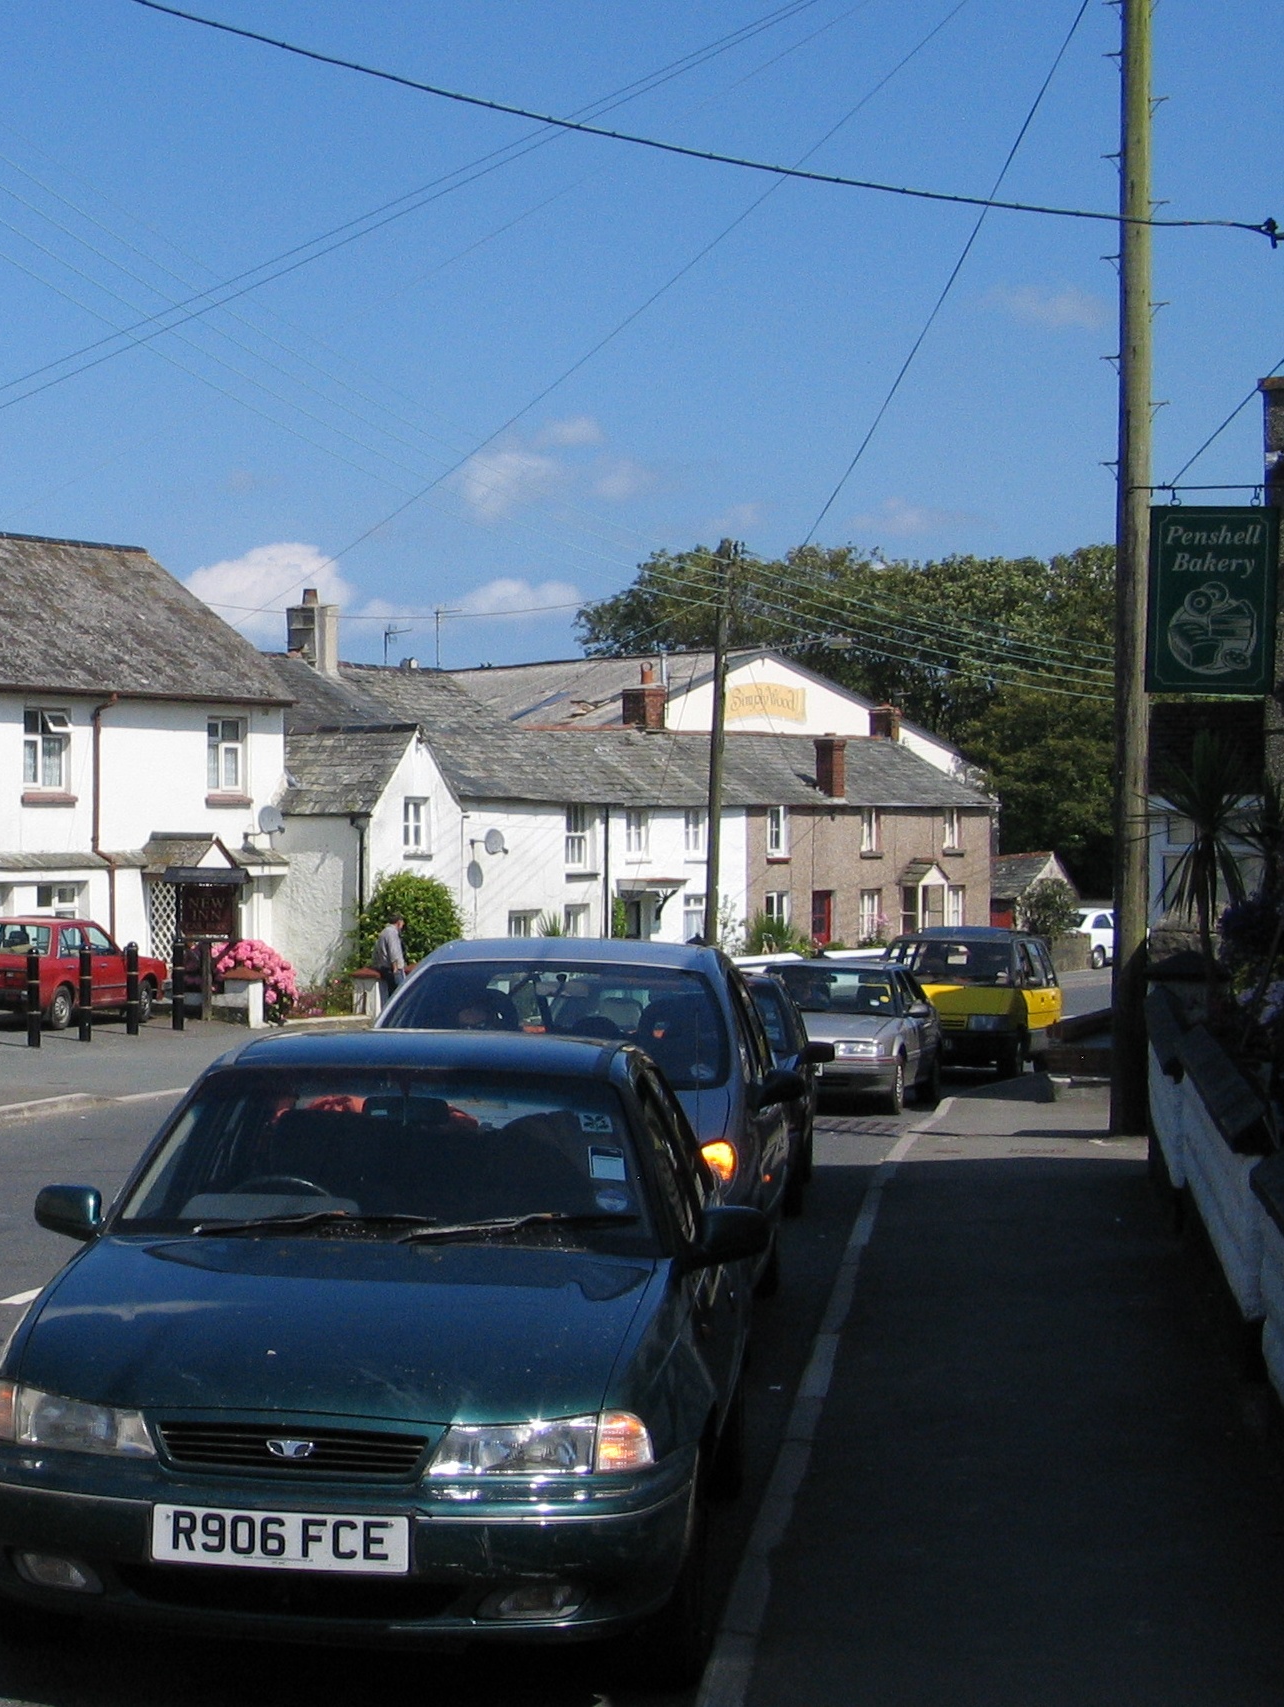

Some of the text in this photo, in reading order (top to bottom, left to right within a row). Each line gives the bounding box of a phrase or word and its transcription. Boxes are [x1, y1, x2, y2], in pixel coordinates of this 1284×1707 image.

[1166, 524, 1262, 545] Penshell
[1172, 551, 1255, 579] Bakery
[188, 897, 226, 909] NEW
[192, 909, 222, 921] INN
[171, 1510, 390, 1561] R906 FCE
